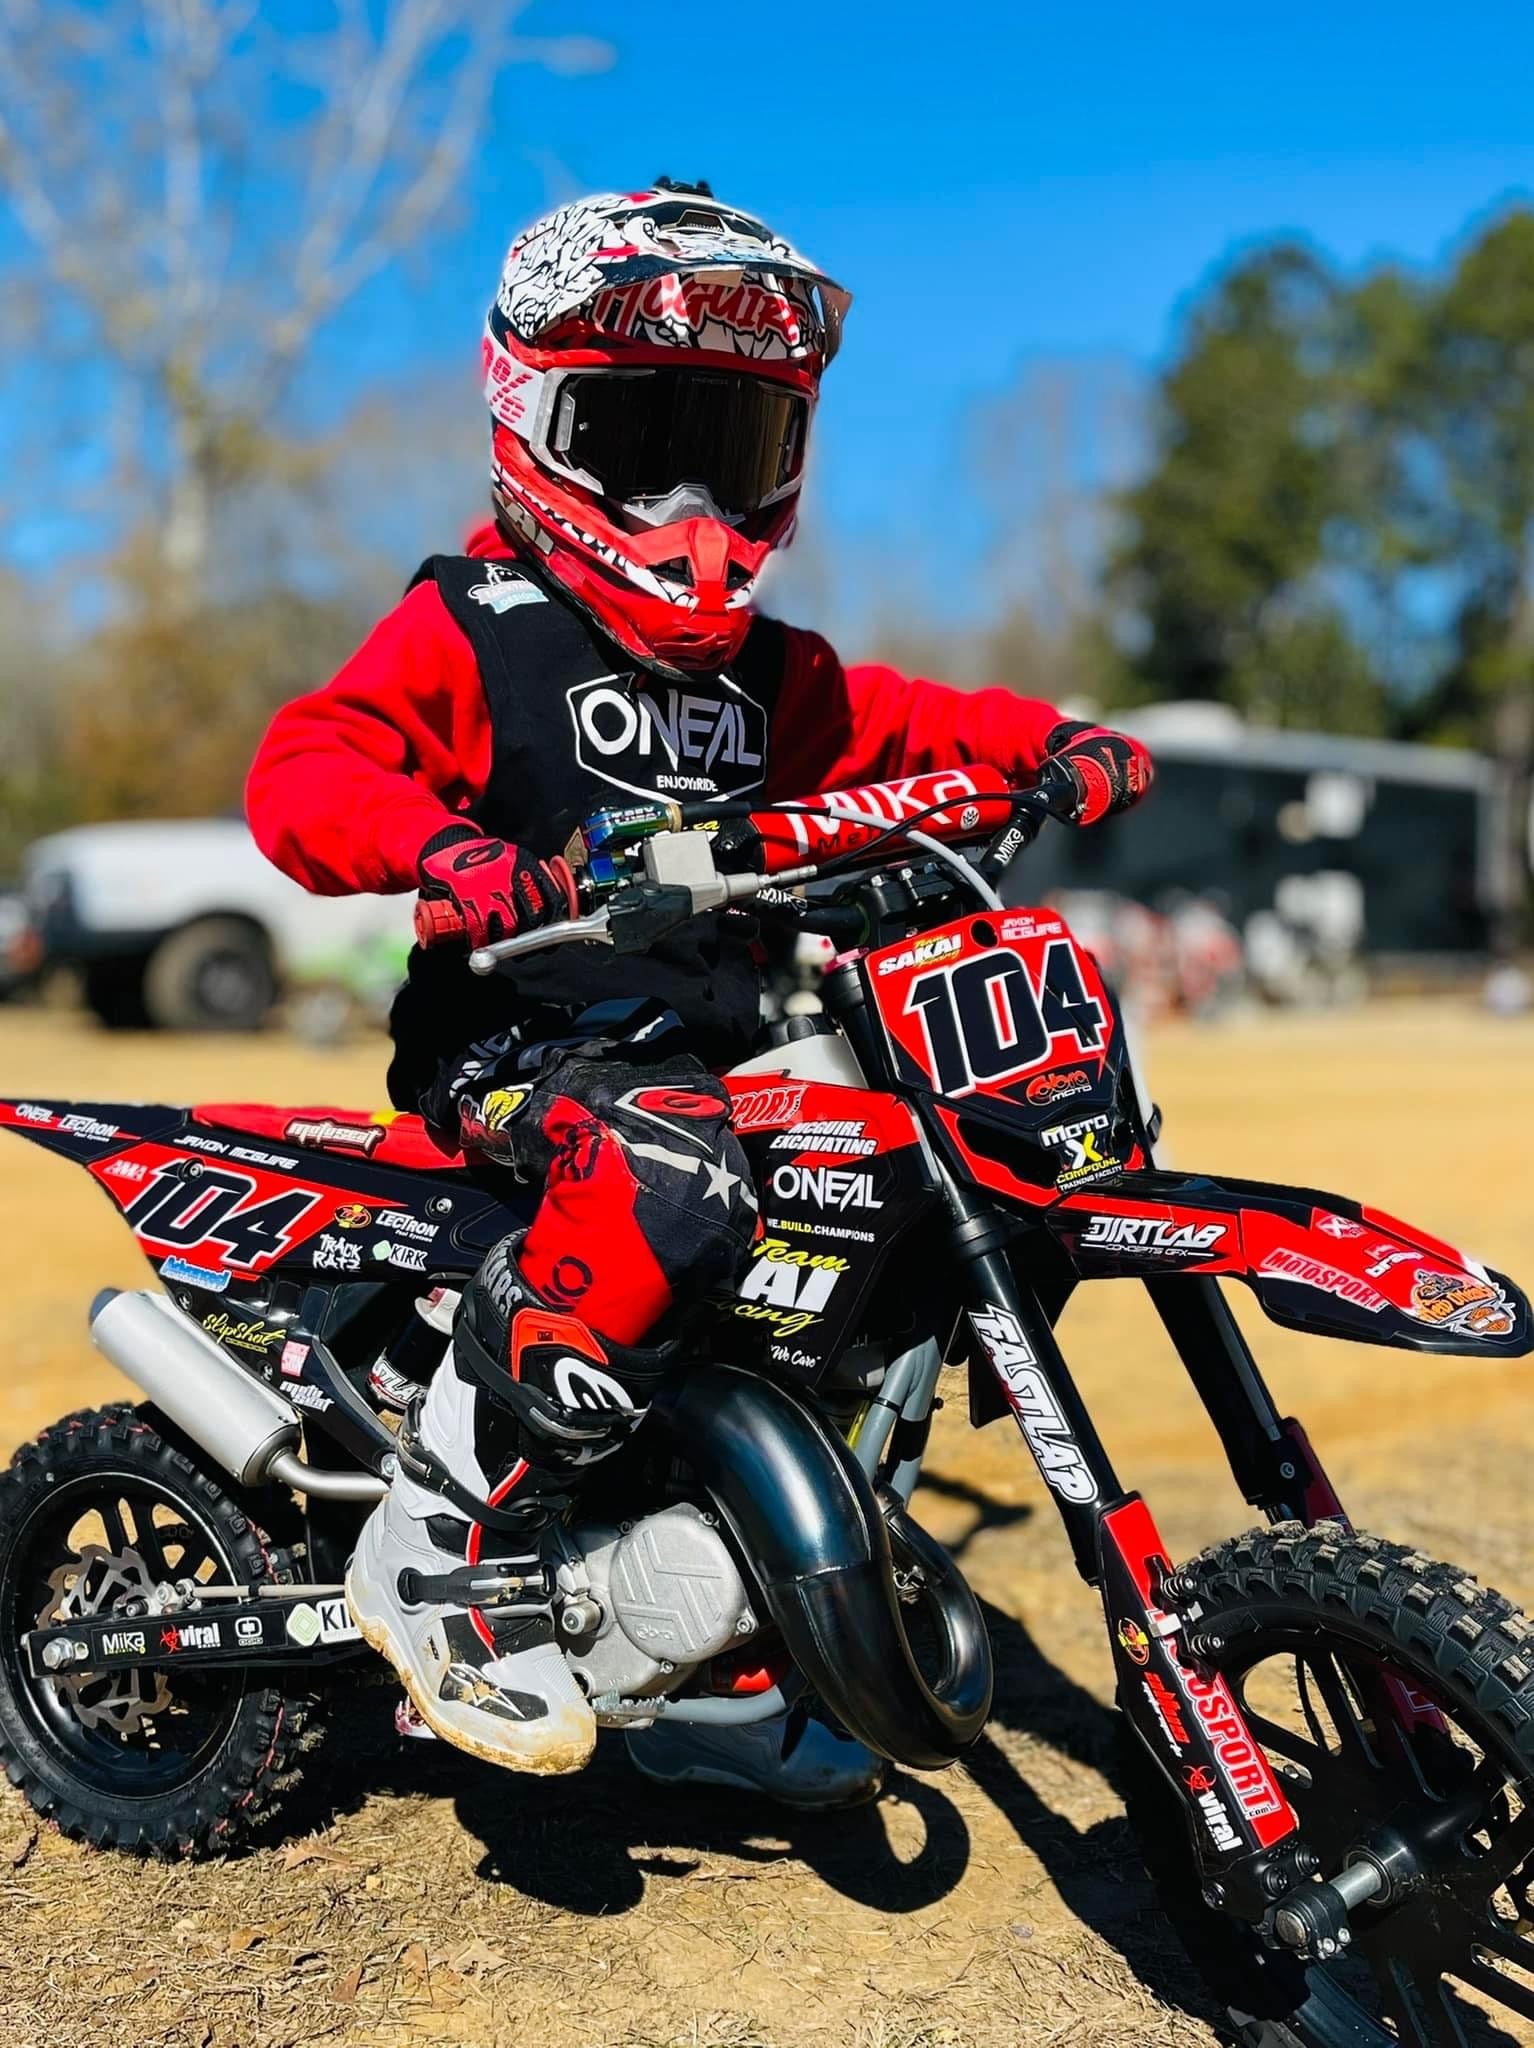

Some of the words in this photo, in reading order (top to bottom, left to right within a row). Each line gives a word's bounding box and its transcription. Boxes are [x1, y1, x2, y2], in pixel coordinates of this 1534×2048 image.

[878, 934, 962, 977] SAKAI
[902, 938, 1108, 1099] 104
[58, 1114, 120, 1138] LECTRON
[1041, 1114, 1109, 1147] MOTO
[173, 1135, 231, 1157] JAXON
[769, 1135, 878, 1156] EXCAVATING
[1060, 1173, 1096, 1192] TRAINING
[125, 1158, 325, 1268] 104
[375, 1209, 440, 1238] LECTRON
[319, 1232, 363, 1260] TRACK
[1081, 1215, 1227, 1249] DIRTLAB
[390, 1244, 428, 1270] KIRK
[752, 1237, 851, 1272] Team
[1262, 1250, 1386, 1309] MOTOSPORT
[320, 1603, 355, 1631] KI
[179, 1622, 221, 1648] viral
[1198, 1790, 1244, 1851] viral
